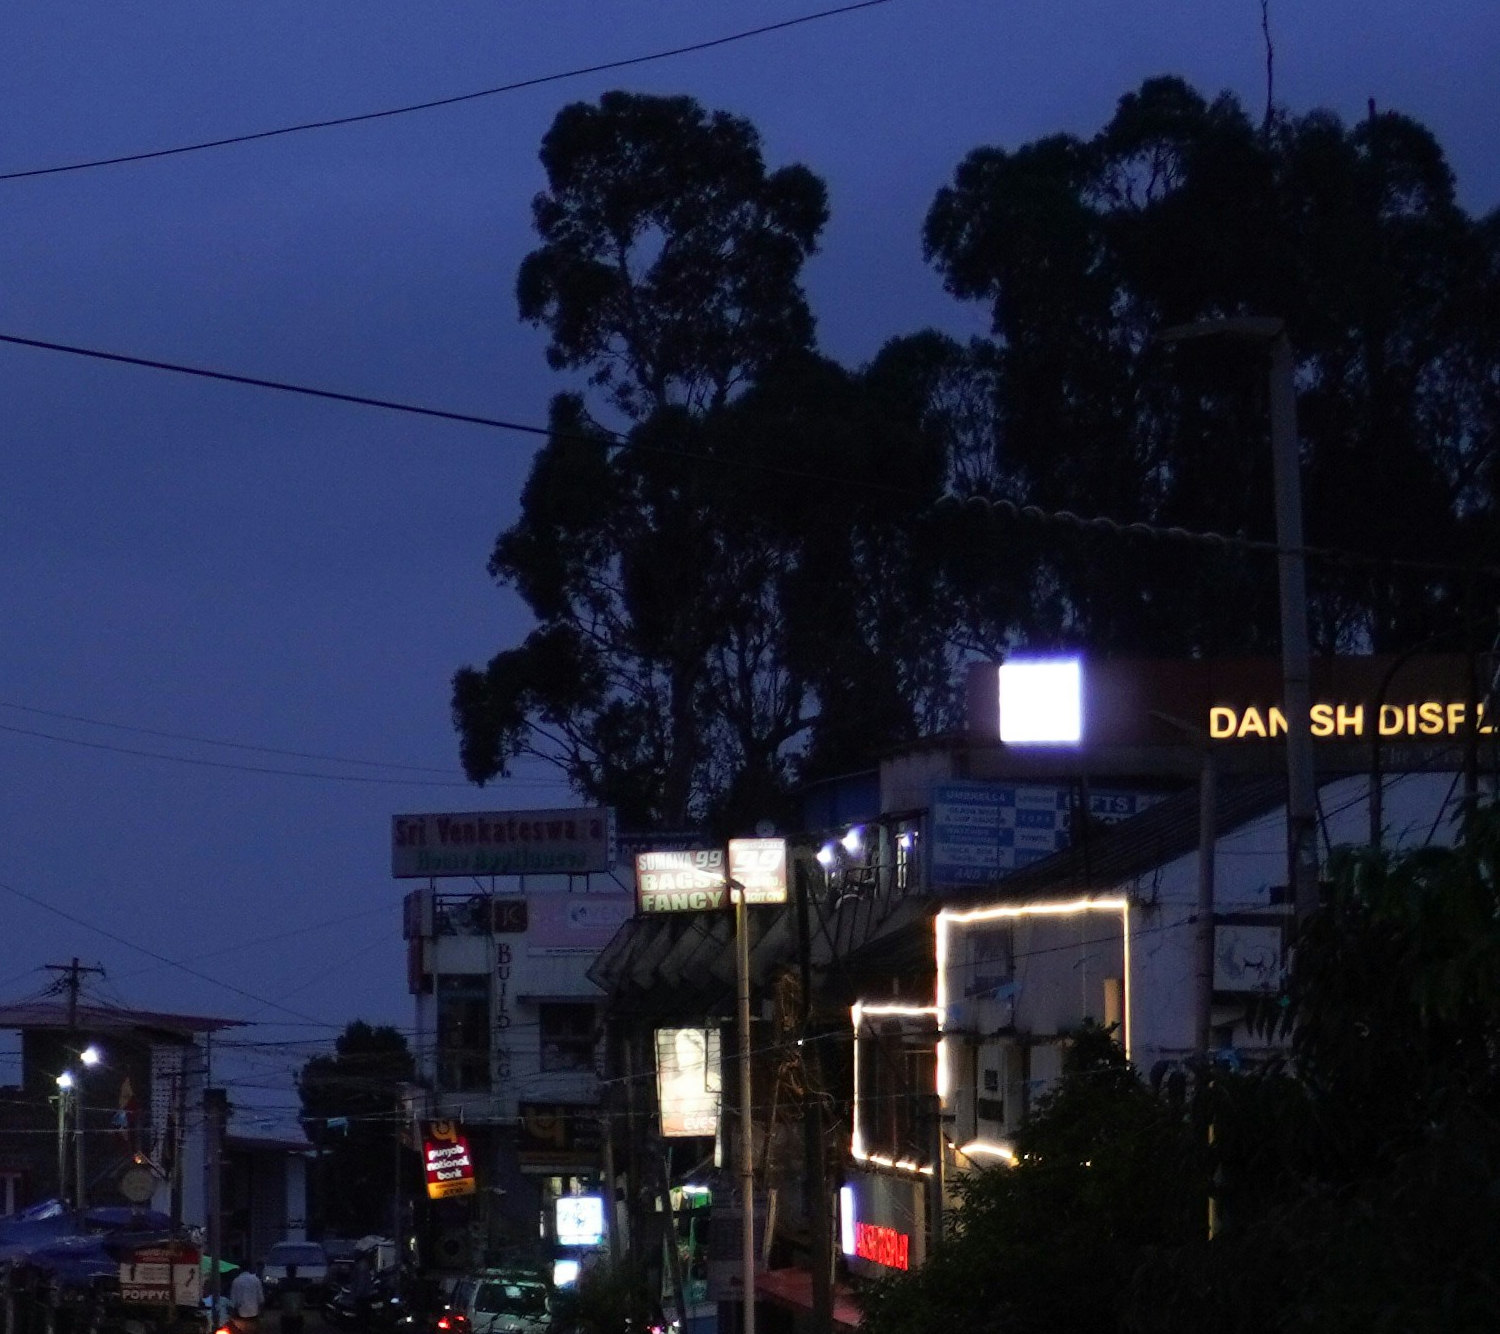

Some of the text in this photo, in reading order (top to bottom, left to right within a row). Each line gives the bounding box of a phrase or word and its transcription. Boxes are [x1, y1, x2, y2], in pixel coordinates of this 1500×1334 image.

[1208, 703, 1364, 739] DANSH
[395, 815, 600, 846] Sri Venkateswaa
[642, 892, 724, 912] FANCY
[428, 1145, 465, 1160] punjab
[427, 1156, 470, 1171] national
[436, 1168, 463, 1180] bank
